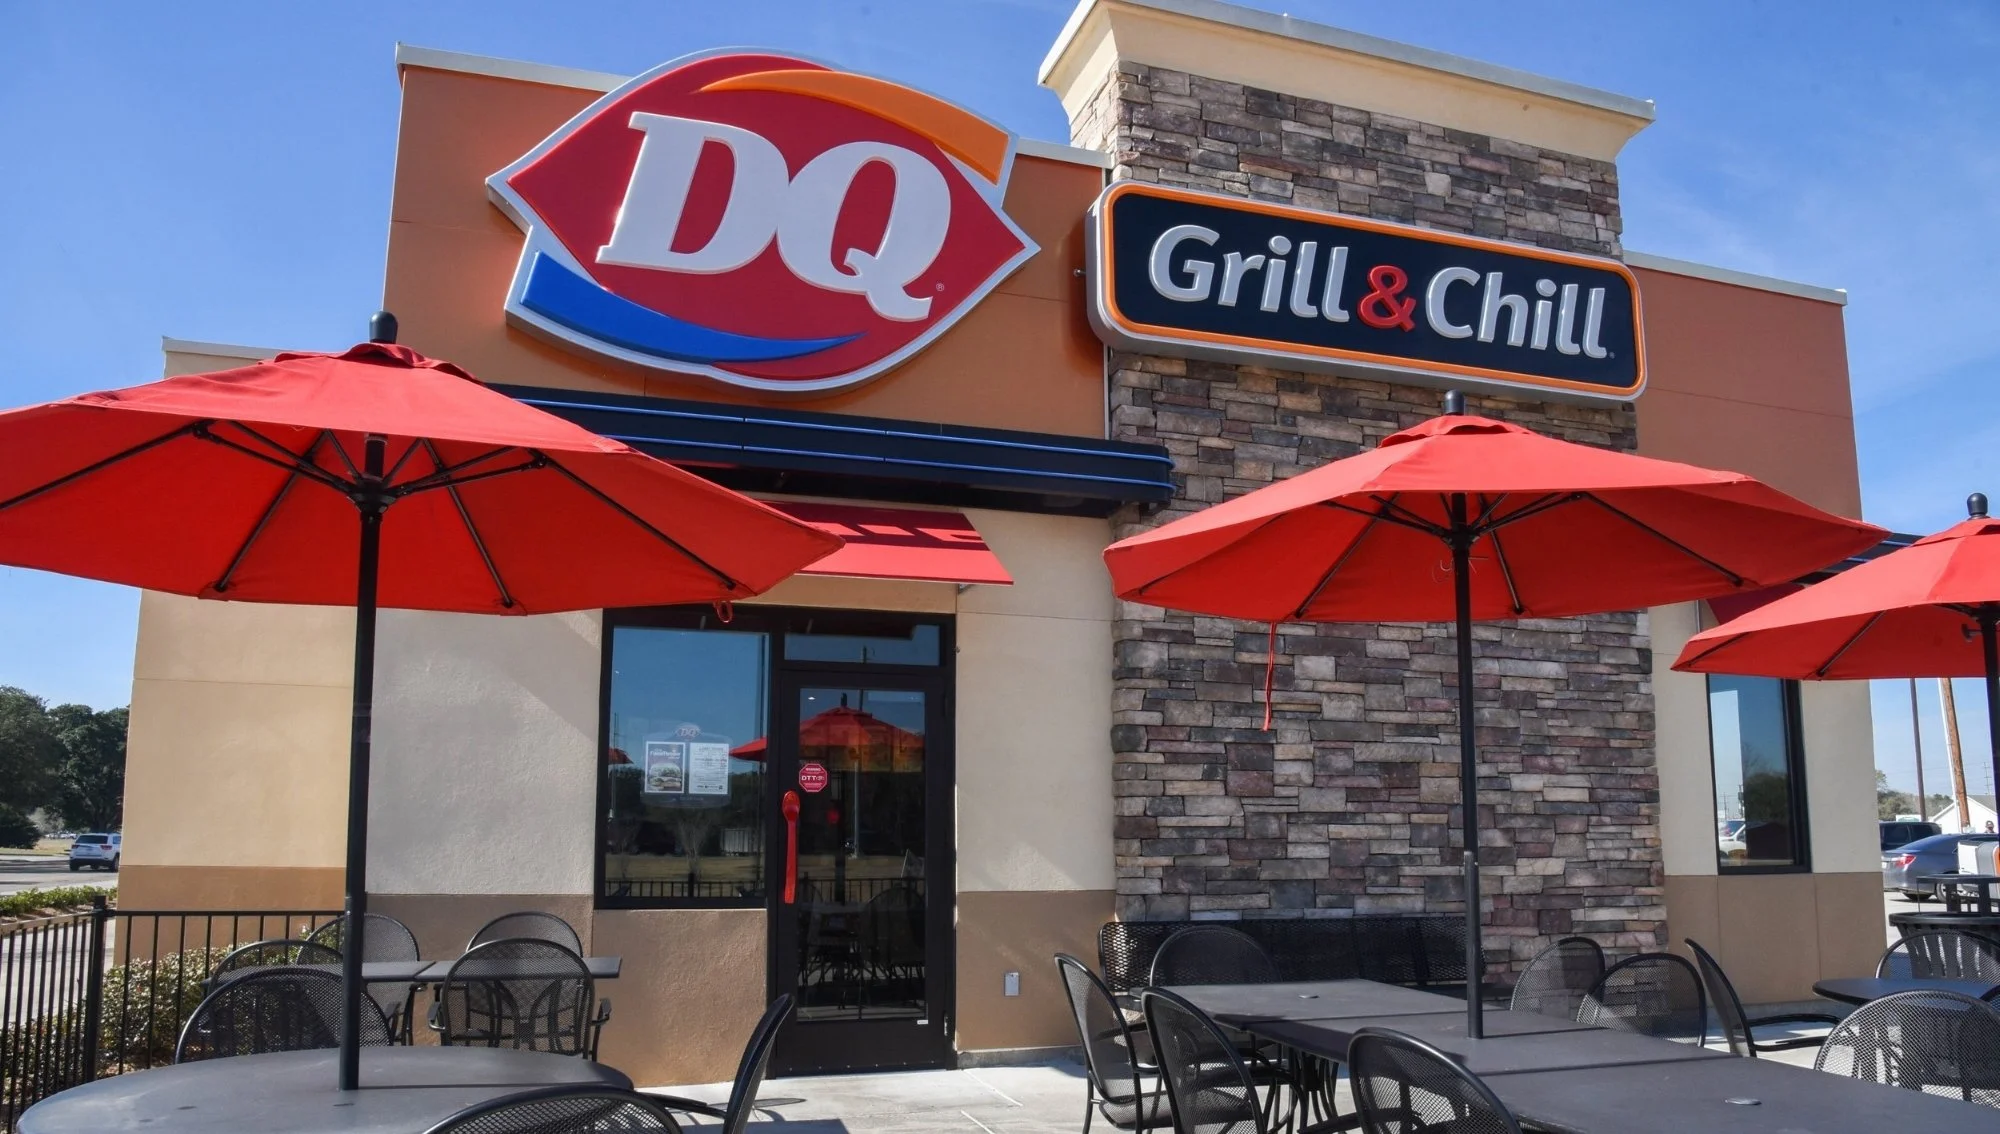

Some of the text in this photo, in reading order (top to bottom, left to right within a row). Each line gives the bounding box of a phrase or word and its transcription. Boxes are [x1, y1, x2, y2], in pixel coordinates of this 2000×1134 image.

[595, 111, 933, 322] DQ
[1148, 223, 1608, 360] Grill & Chill
[680, 727, 698, 738] DQ
